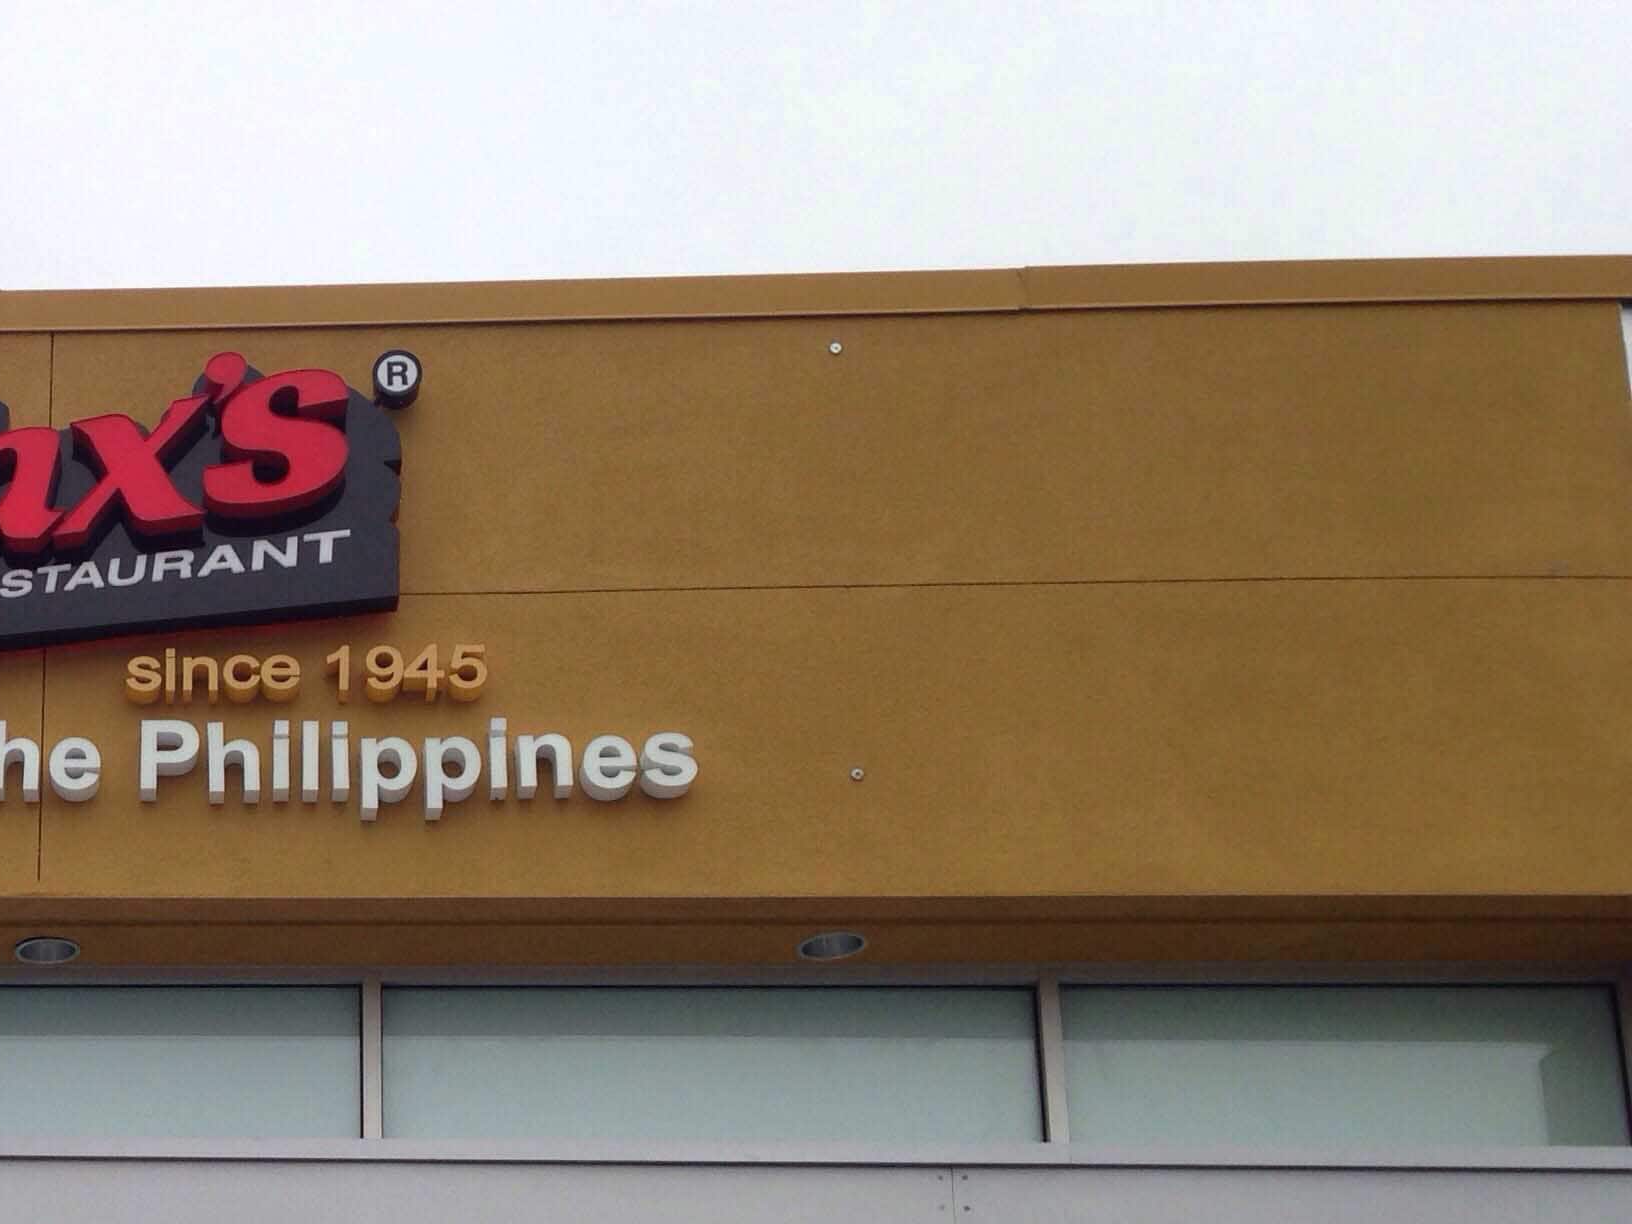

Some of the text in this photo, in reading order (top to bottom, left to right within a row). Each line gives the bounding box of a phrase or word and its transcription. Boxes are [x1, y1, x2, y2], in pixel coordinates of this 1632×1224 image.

[126, 643, 487, 704] since 1945
[139, 717, 699, 821] Philippines
